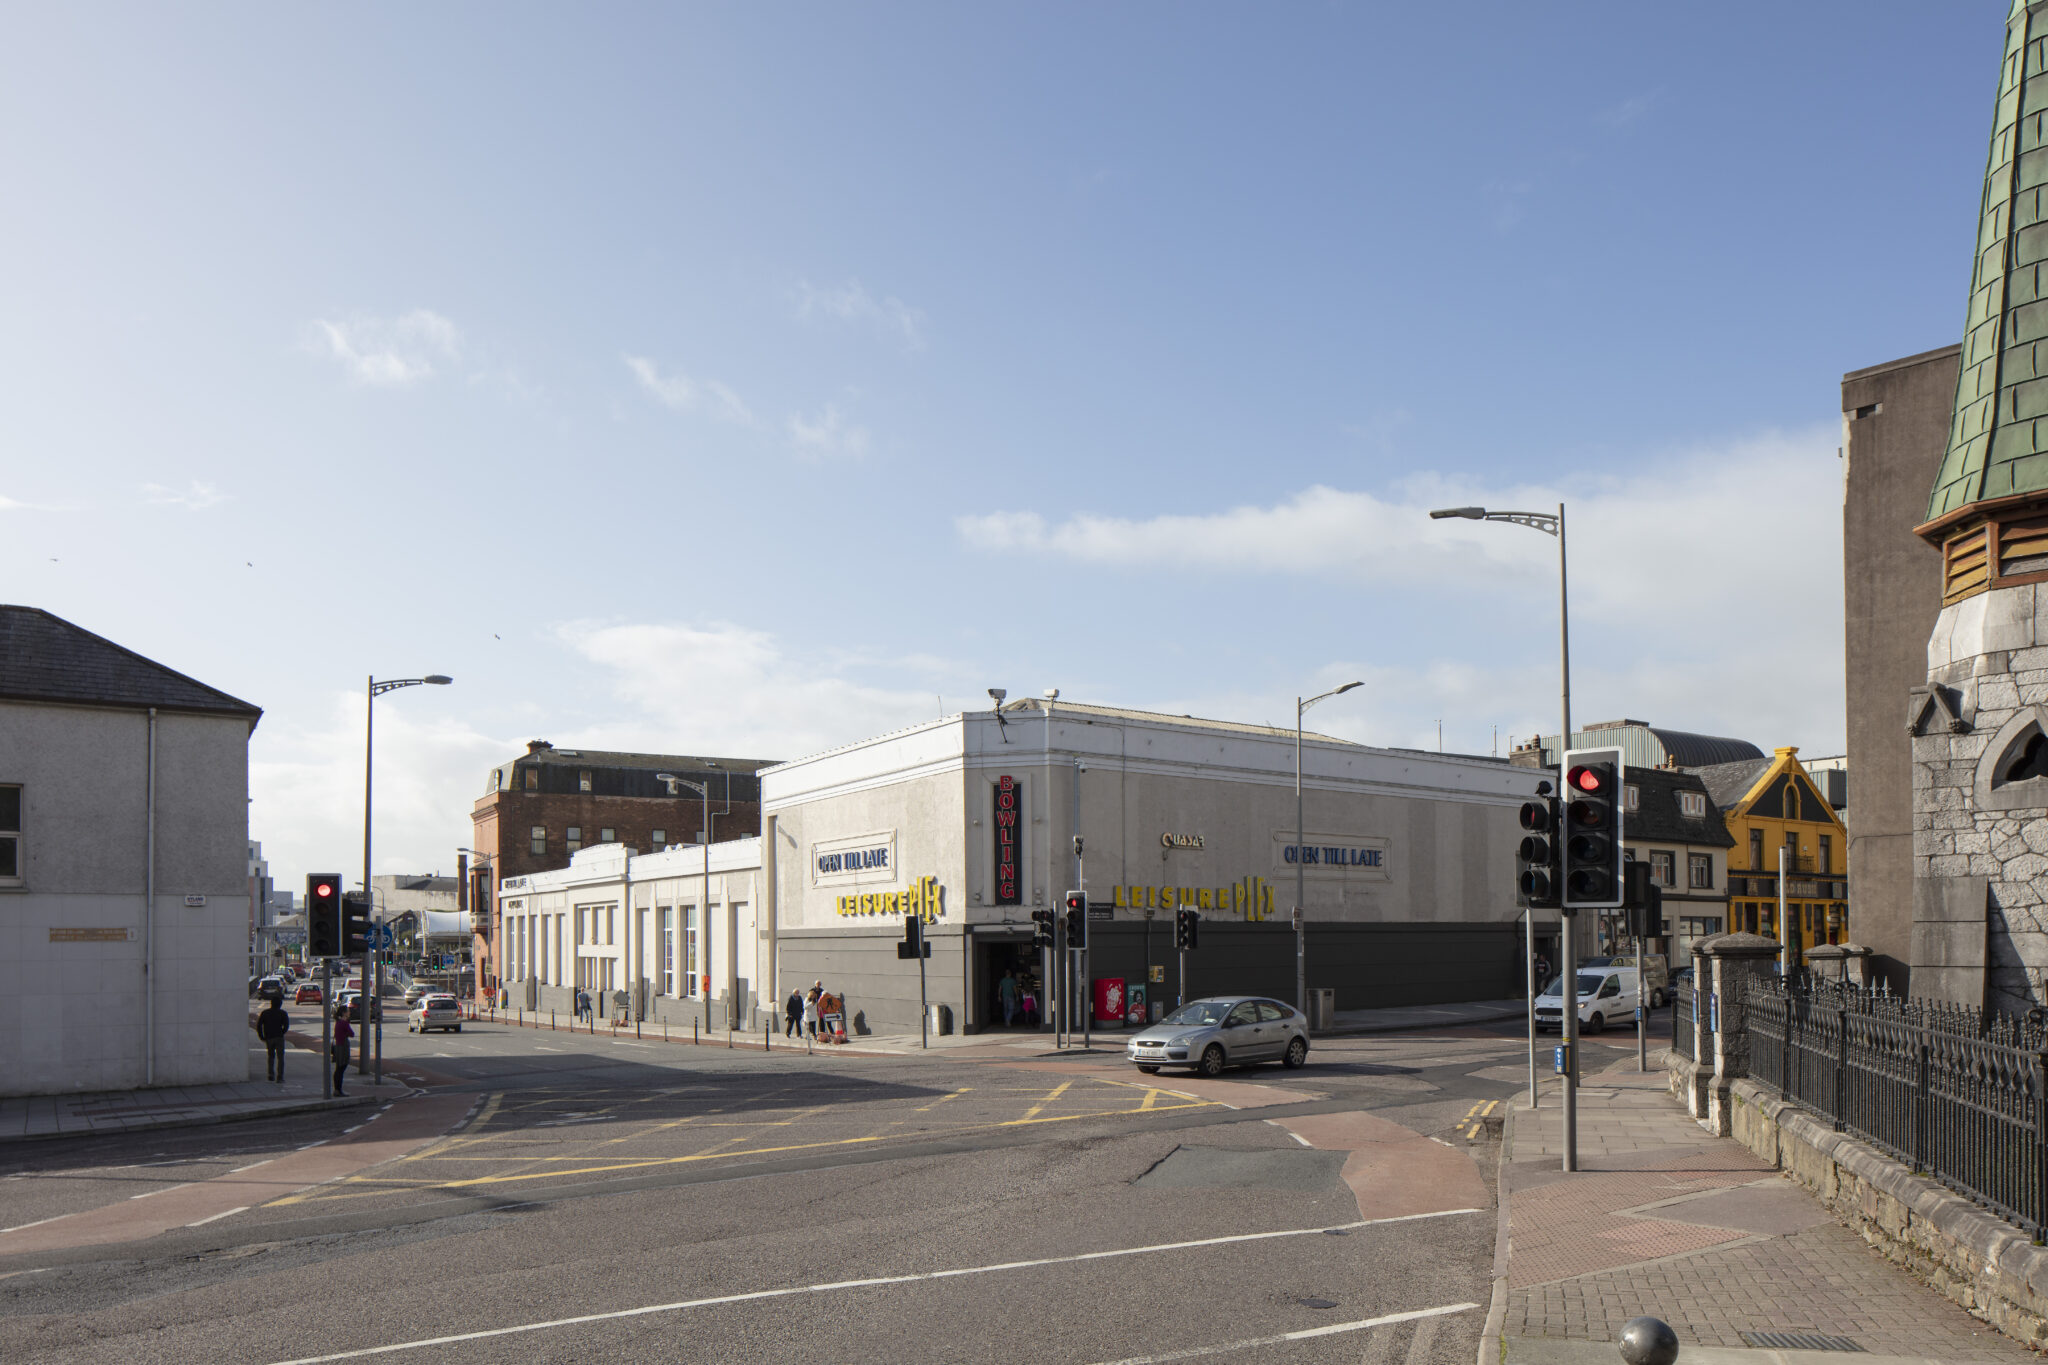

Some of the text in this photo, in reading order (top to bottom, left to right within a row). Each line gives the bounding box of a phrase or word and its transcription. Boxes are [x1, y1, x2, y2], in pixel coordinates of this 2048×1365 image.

[997, 775, 1016, 898] BOWLING
[818, 848, 888, 873] OPEN TILL LATE
[1322, 847, 1350, 865] TILL
[1351, 848, 1382, 867] LATE
[1113, 876, 1275, 921] LEISUREPLEX
